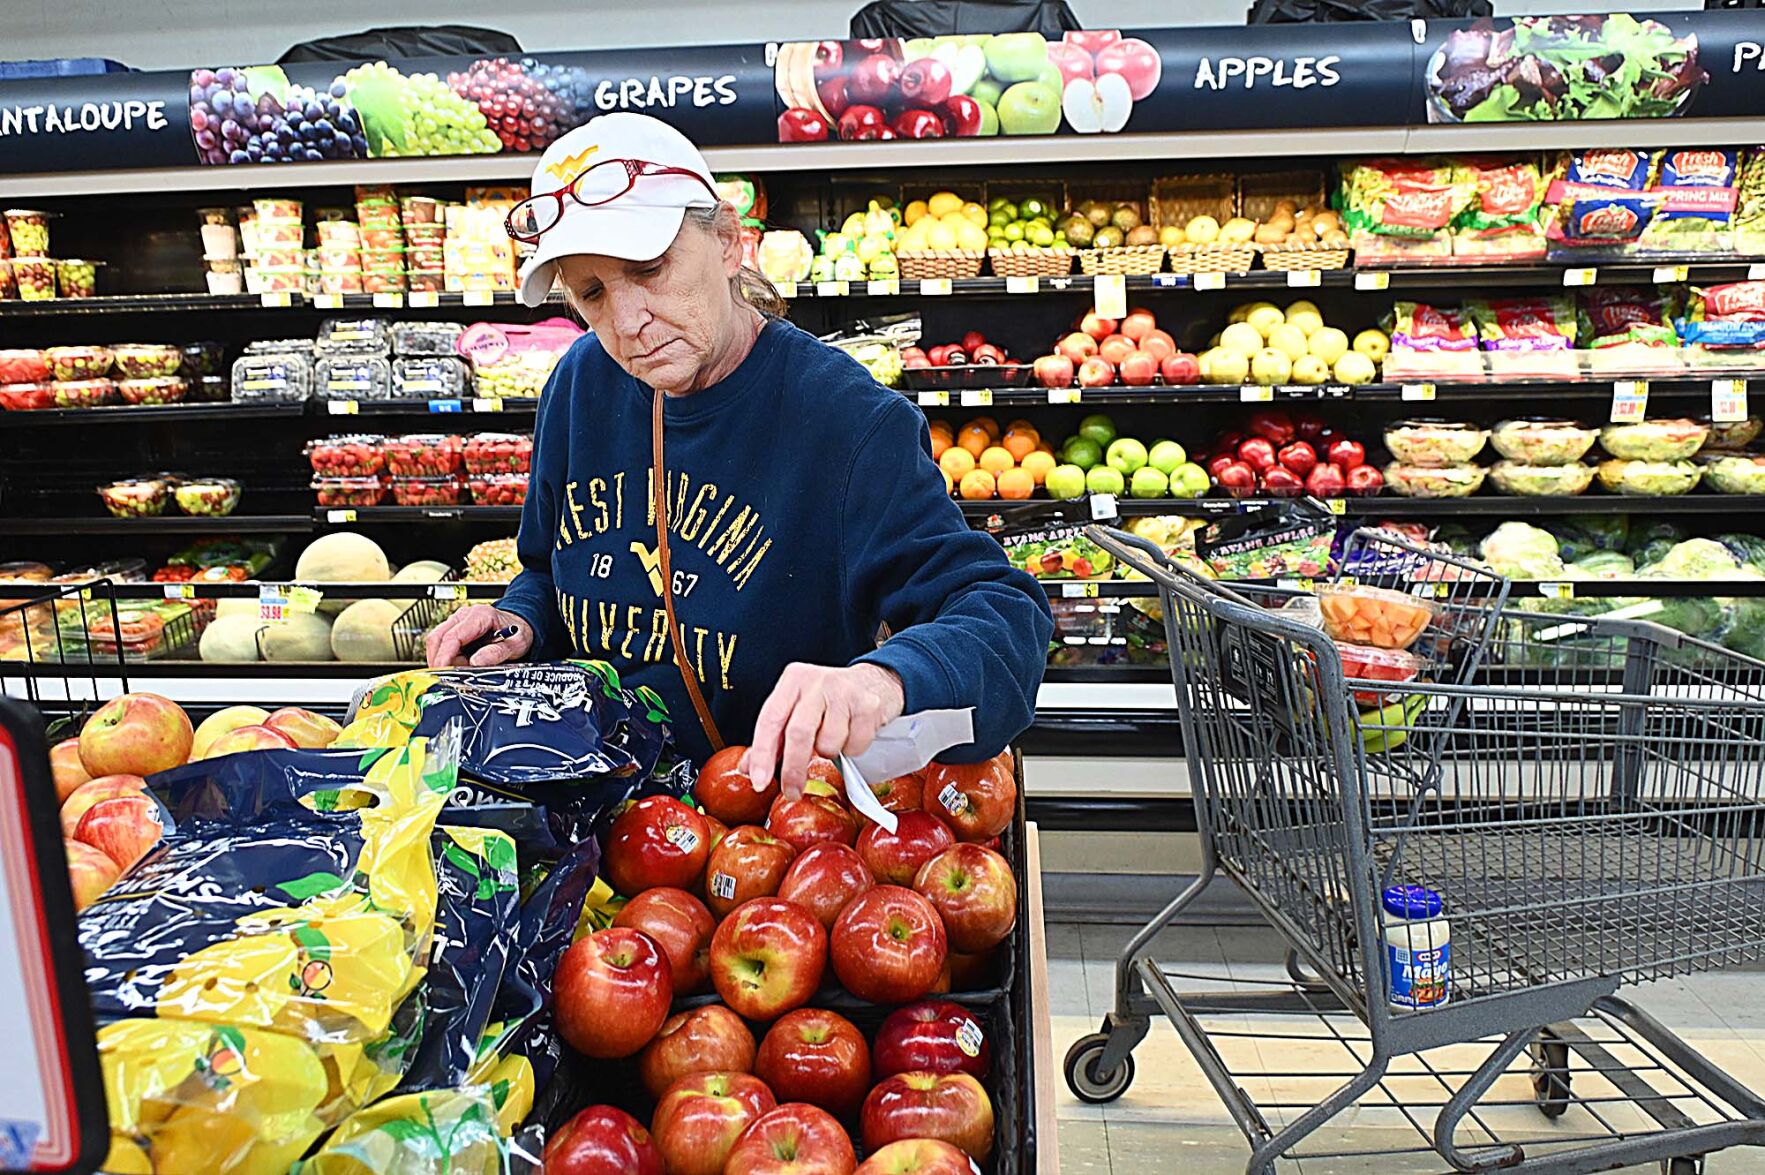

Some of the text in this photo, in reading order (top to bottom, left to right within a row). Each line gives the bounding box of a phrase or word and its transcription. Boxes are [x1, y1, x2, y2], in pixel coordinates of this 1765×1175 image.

[1194, 55, 1341, 91] APPLES
[1732, 42, 1765, 73] P
[594, 75, 738, 111] GRAPES
[0, 101, 169, 137] NTALOUPE
[590, 553, 613, 579] 18
[672, 570, 699, 597] 67
[556, 584, 738, 691] NIVERITY
[530, 670, 543, 681] OF
[1402, 961, 1448, 980] Mayo
